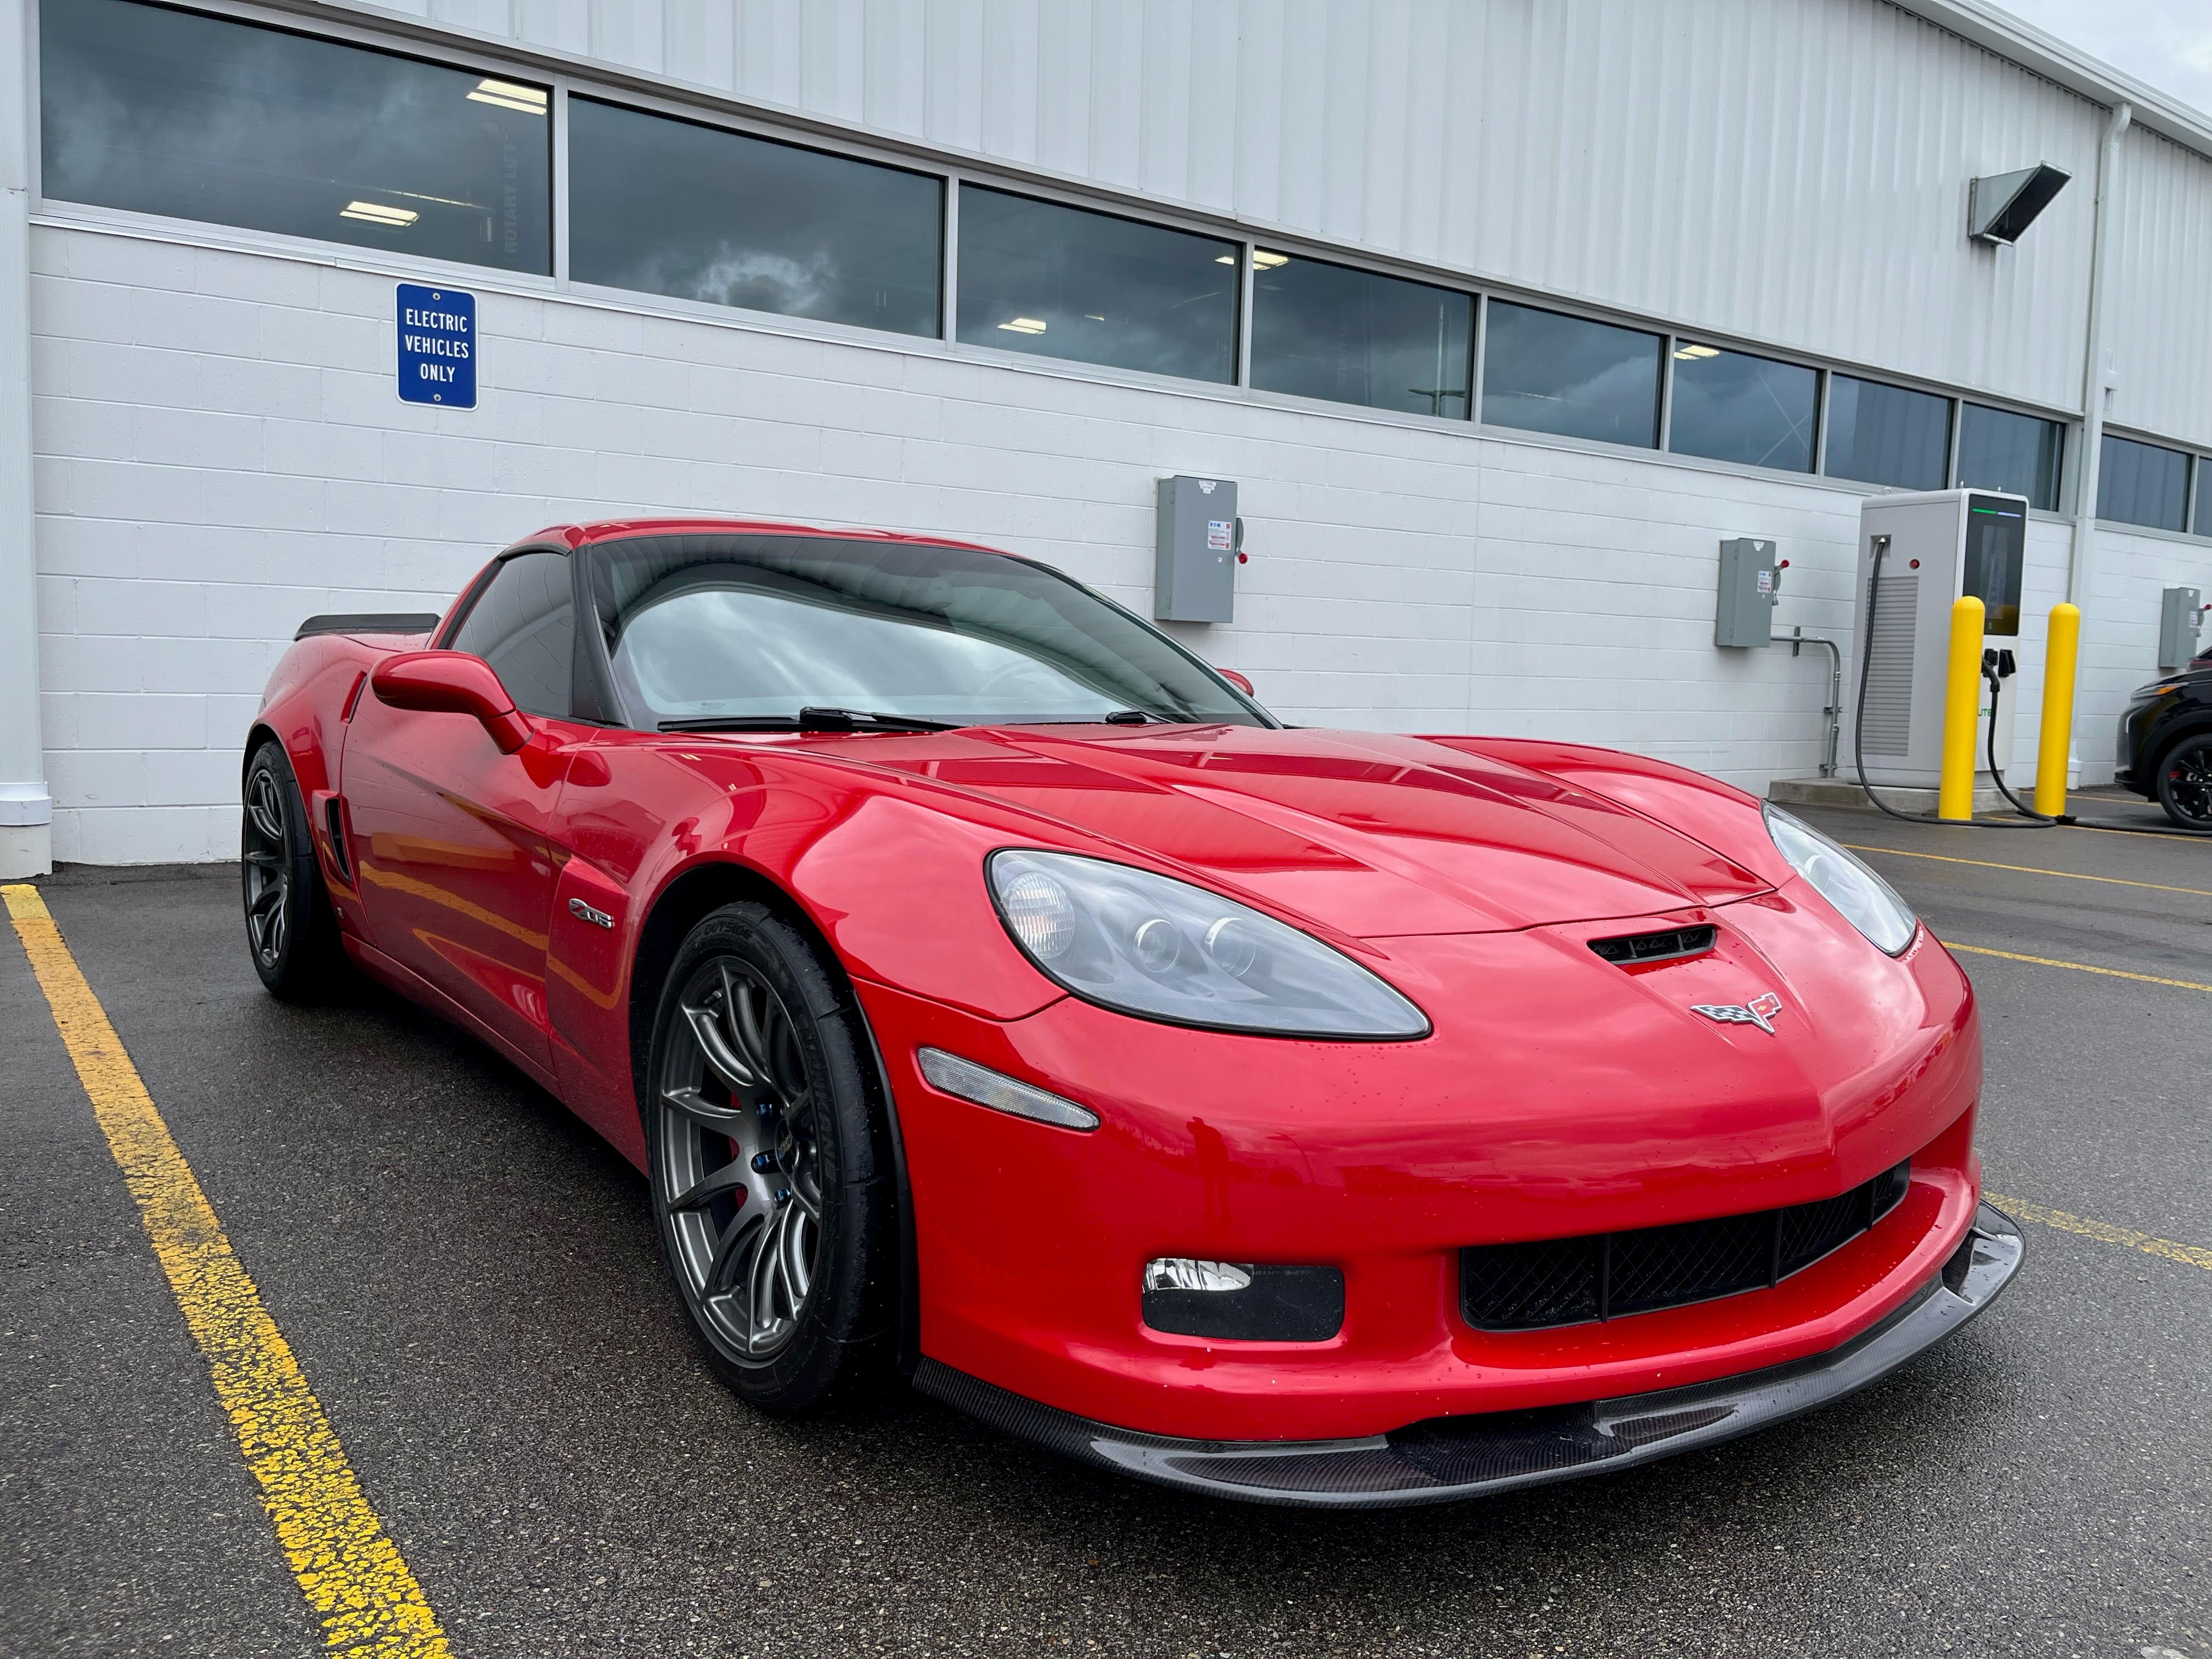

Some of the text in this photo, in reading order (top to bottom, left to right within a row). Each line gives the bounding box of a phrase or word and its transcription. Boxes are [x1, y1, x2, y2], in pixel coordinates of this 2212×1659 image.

[504, 184, 518, 253] ROTARY
[406, 308, 467, 332] ELECTRIC
[405, 335, 469, 358] VEHICLES
[420, 363, 455, 382] ONLY
[704, 921, 753, 940] OUTSIDE
